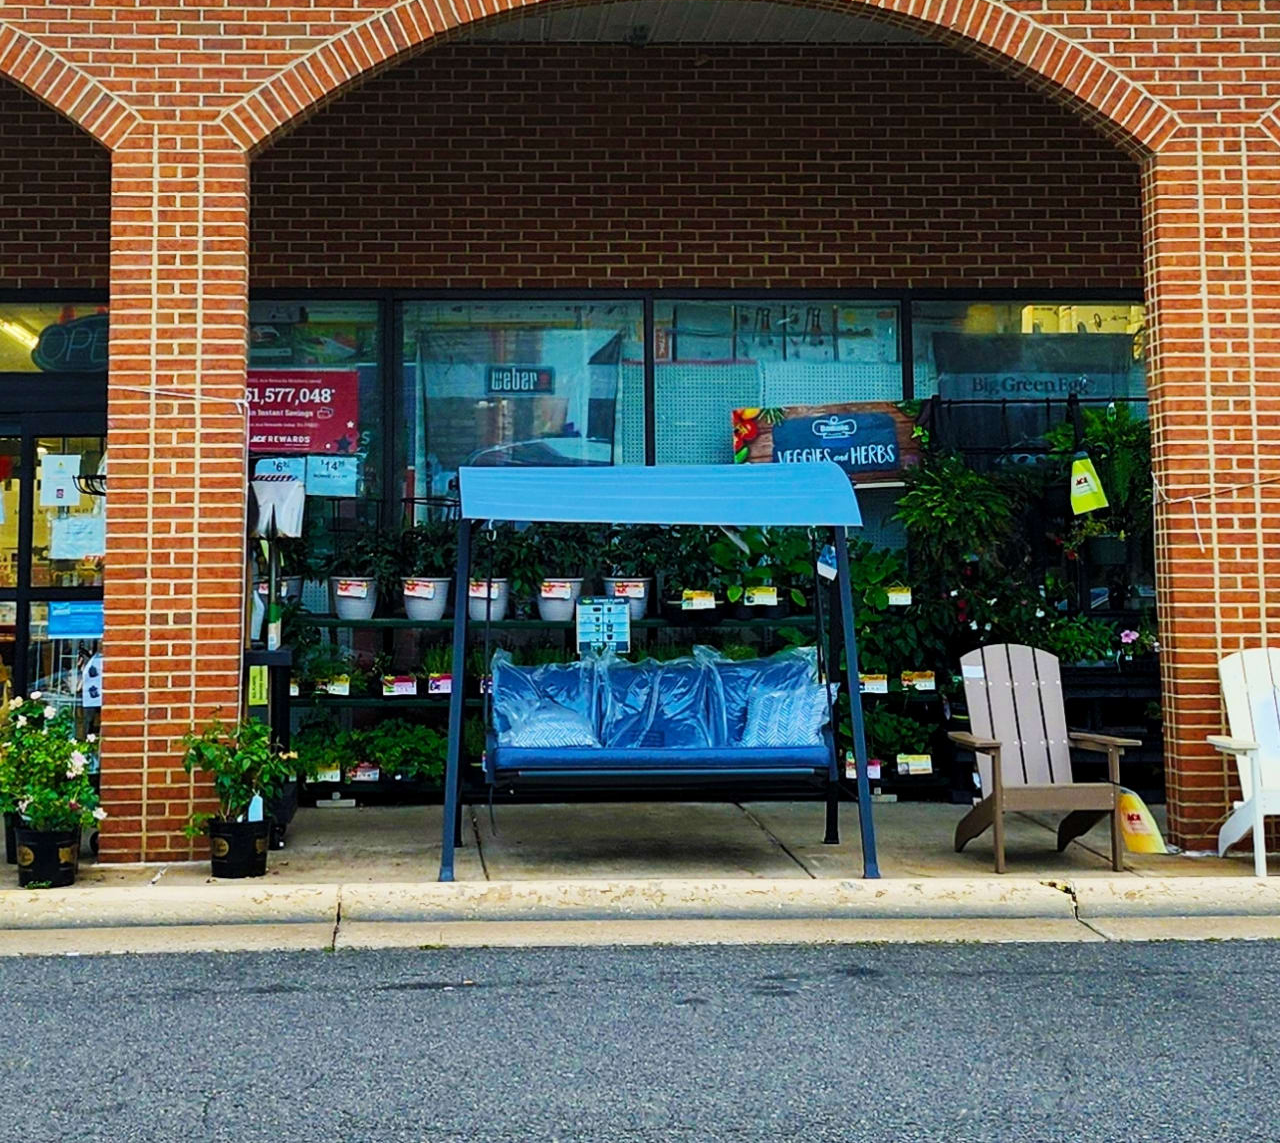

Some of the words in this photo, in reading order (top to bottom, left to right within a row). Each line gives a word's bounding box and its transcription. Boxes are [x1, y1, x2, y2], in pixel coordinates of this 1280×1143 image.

[41, 328, 108, 361] OPE
[491, 367, 538, 390] weber
[972, 376, 999, 395] Big
[1001, 376, 1055, 392] Green
[258, 409, 284, 417] Instant
[285, 409, 314, 419] Savings
[250, 435, 268, 443] ACE
[268, 435, 311, 443] REWARDS
[777, 448, 831, 463] VEGGIES
[850, 443, 895, 466] HERBS
